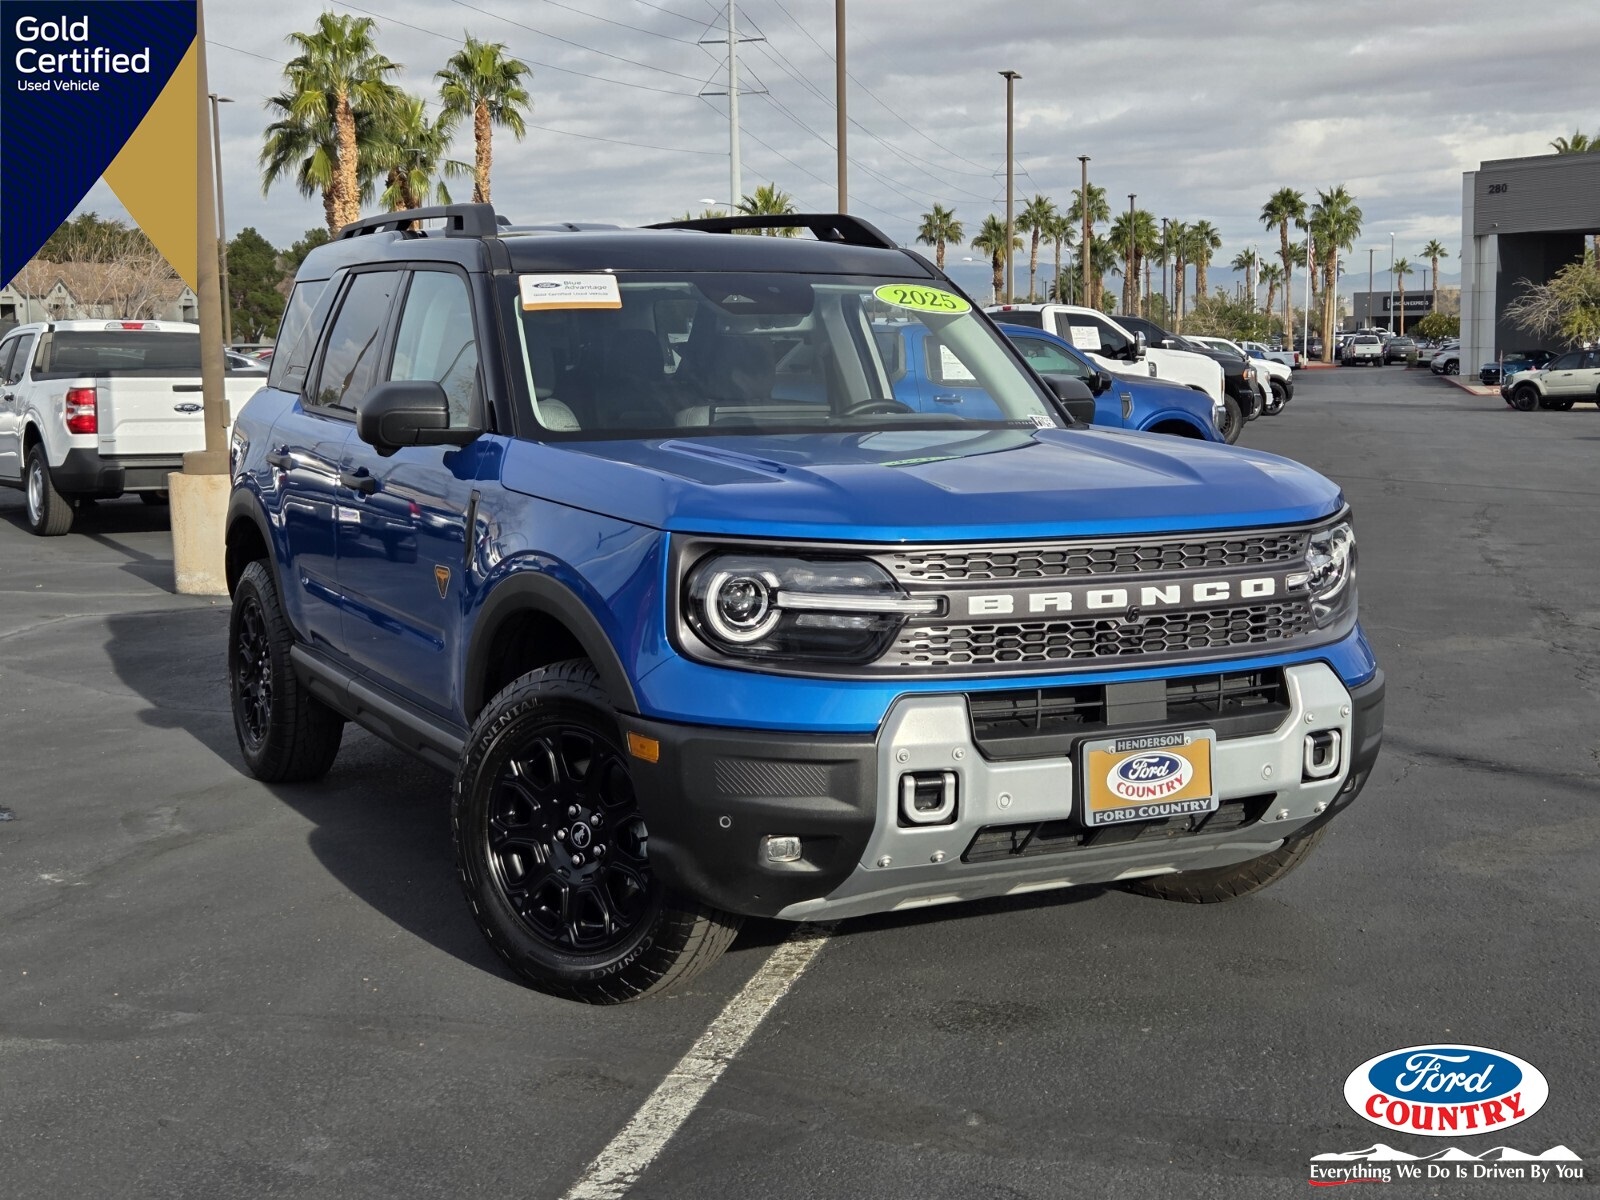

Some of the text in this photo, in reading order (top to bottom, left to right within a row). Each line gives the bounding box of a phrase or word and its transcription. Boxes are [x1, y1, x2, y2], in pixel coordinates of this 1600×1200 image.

[1488, 183, 1507, 194] 280
[893, 289, 957, 309] 2025
[968, 577, 1275, 615] BRONCO
[1117, 735, 1182, 751] HENDERSON
[1128, 757, 1170, 780] Ford
[1116, 774, 1184, 798] COUNTRY
[1095, 799, 1210, 823] FORD COUNTRY
